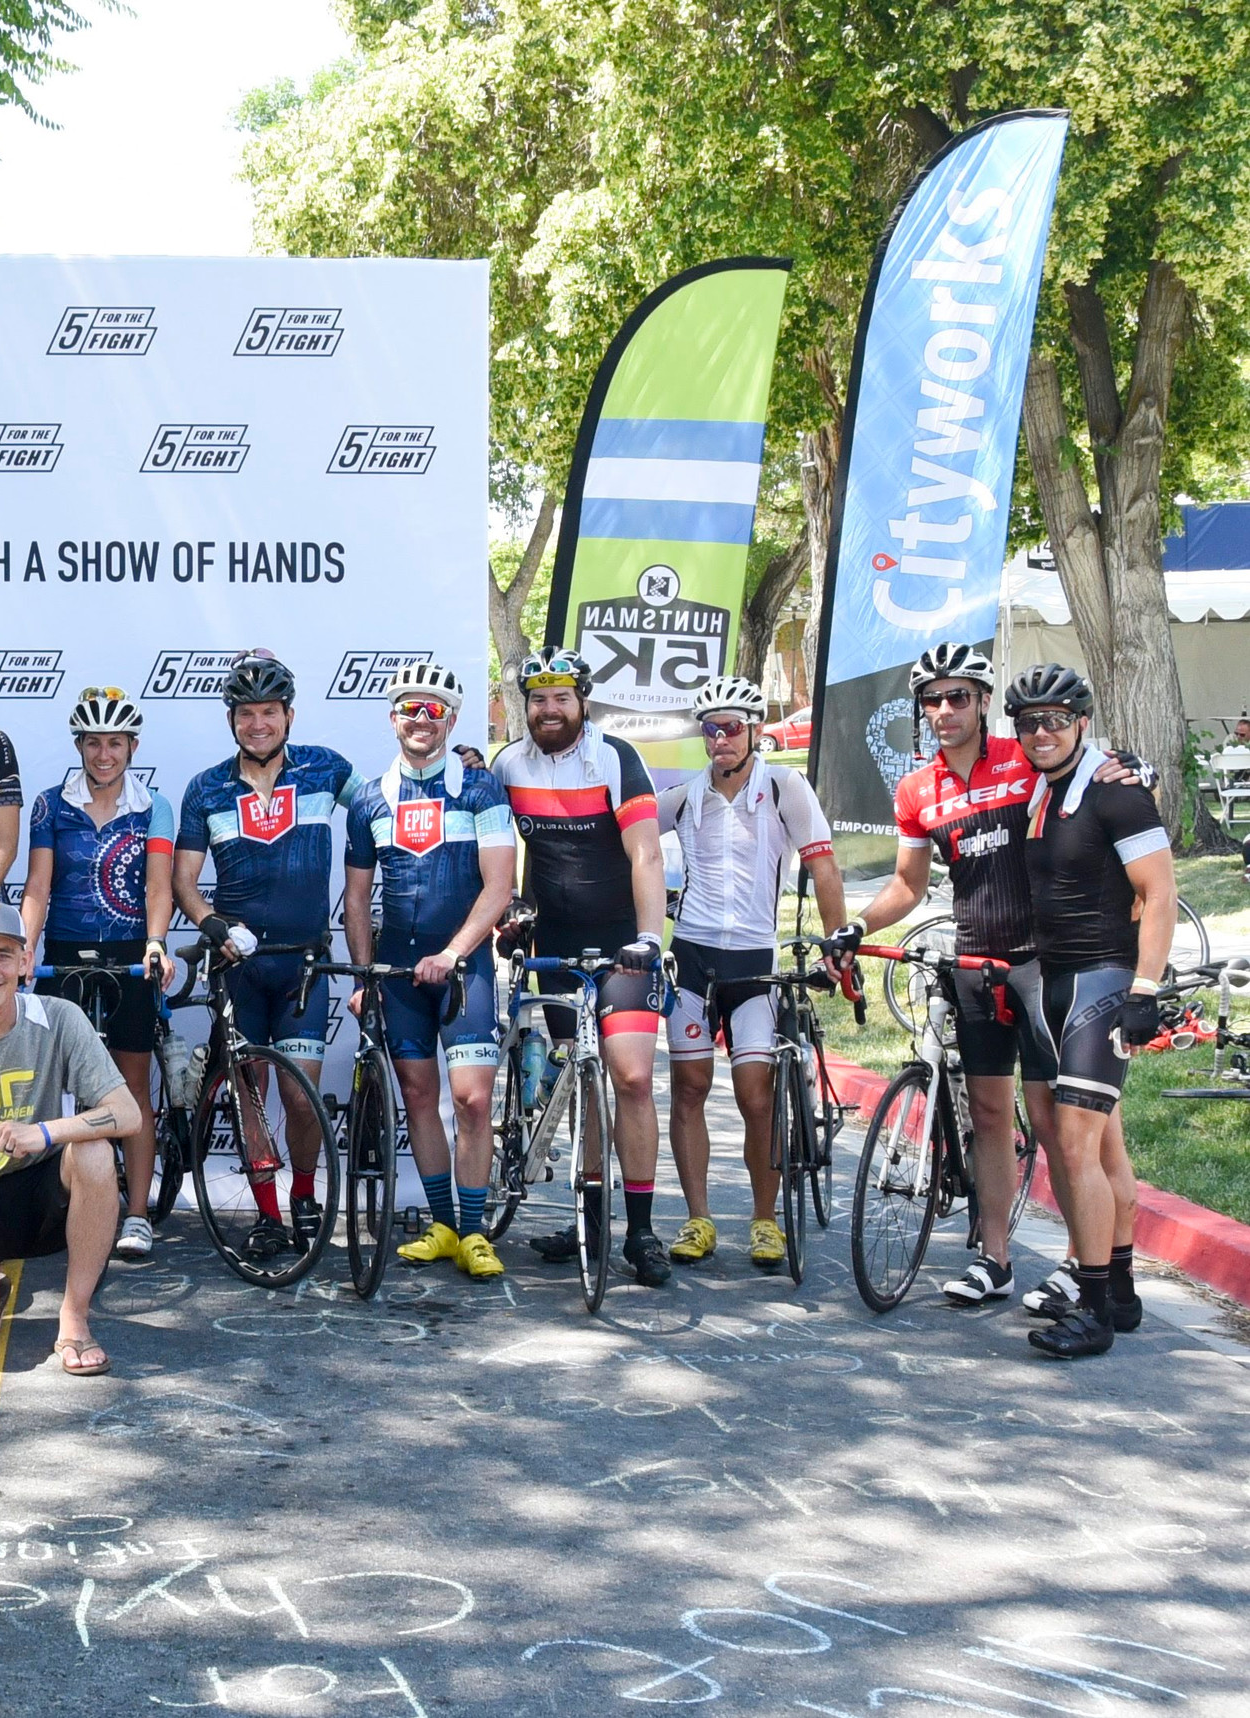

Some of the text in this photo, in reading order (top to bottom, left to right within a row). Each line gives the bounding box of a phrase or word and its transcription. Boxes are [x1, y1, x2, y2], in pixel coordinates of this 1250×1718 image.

[99, 314, 143, 323] FOR THE
[286, 315, 330, 324] FOR THE
[58, 314, 88, 350] 5
[245, 315, 275, 351] 5
[88, 333, 146, 350] FIGHT
[275, 334, 333, 351] FIGHT
[871, 184, 1015, 632] Cityworks
[6, 431, 50, 440] FOR THE
[192, 431, 236, 440] FOR THE
[379, 433, 423, 442] FOR THE
[151, 431, 181, 467] 5
[338, 433, 368, 469] 5
[181, 450, 239, 467] FIGHT
[368, 452, 426, 469] FIGHT
[23, 540, 47, 585] A
[57, 540, 160, 585] SHOW
[172, 540, 216, 585] OF
[228, 540, 345, 585] HANDS
[8, 658, 52, 667] FOR THE
[193, 657, 233, 667] FOR TH
[379, 657, 401, 667] FOR
[152, 657, 183, 694] 5
[338, 657, 369, 694] 5
[181, 677, 224, 693] FIGH
[920, 777, 1029, 822] TREK
[404, 808, 434, 832] EPIC
[536, 821, 596, 832] PLURALSIGHT
